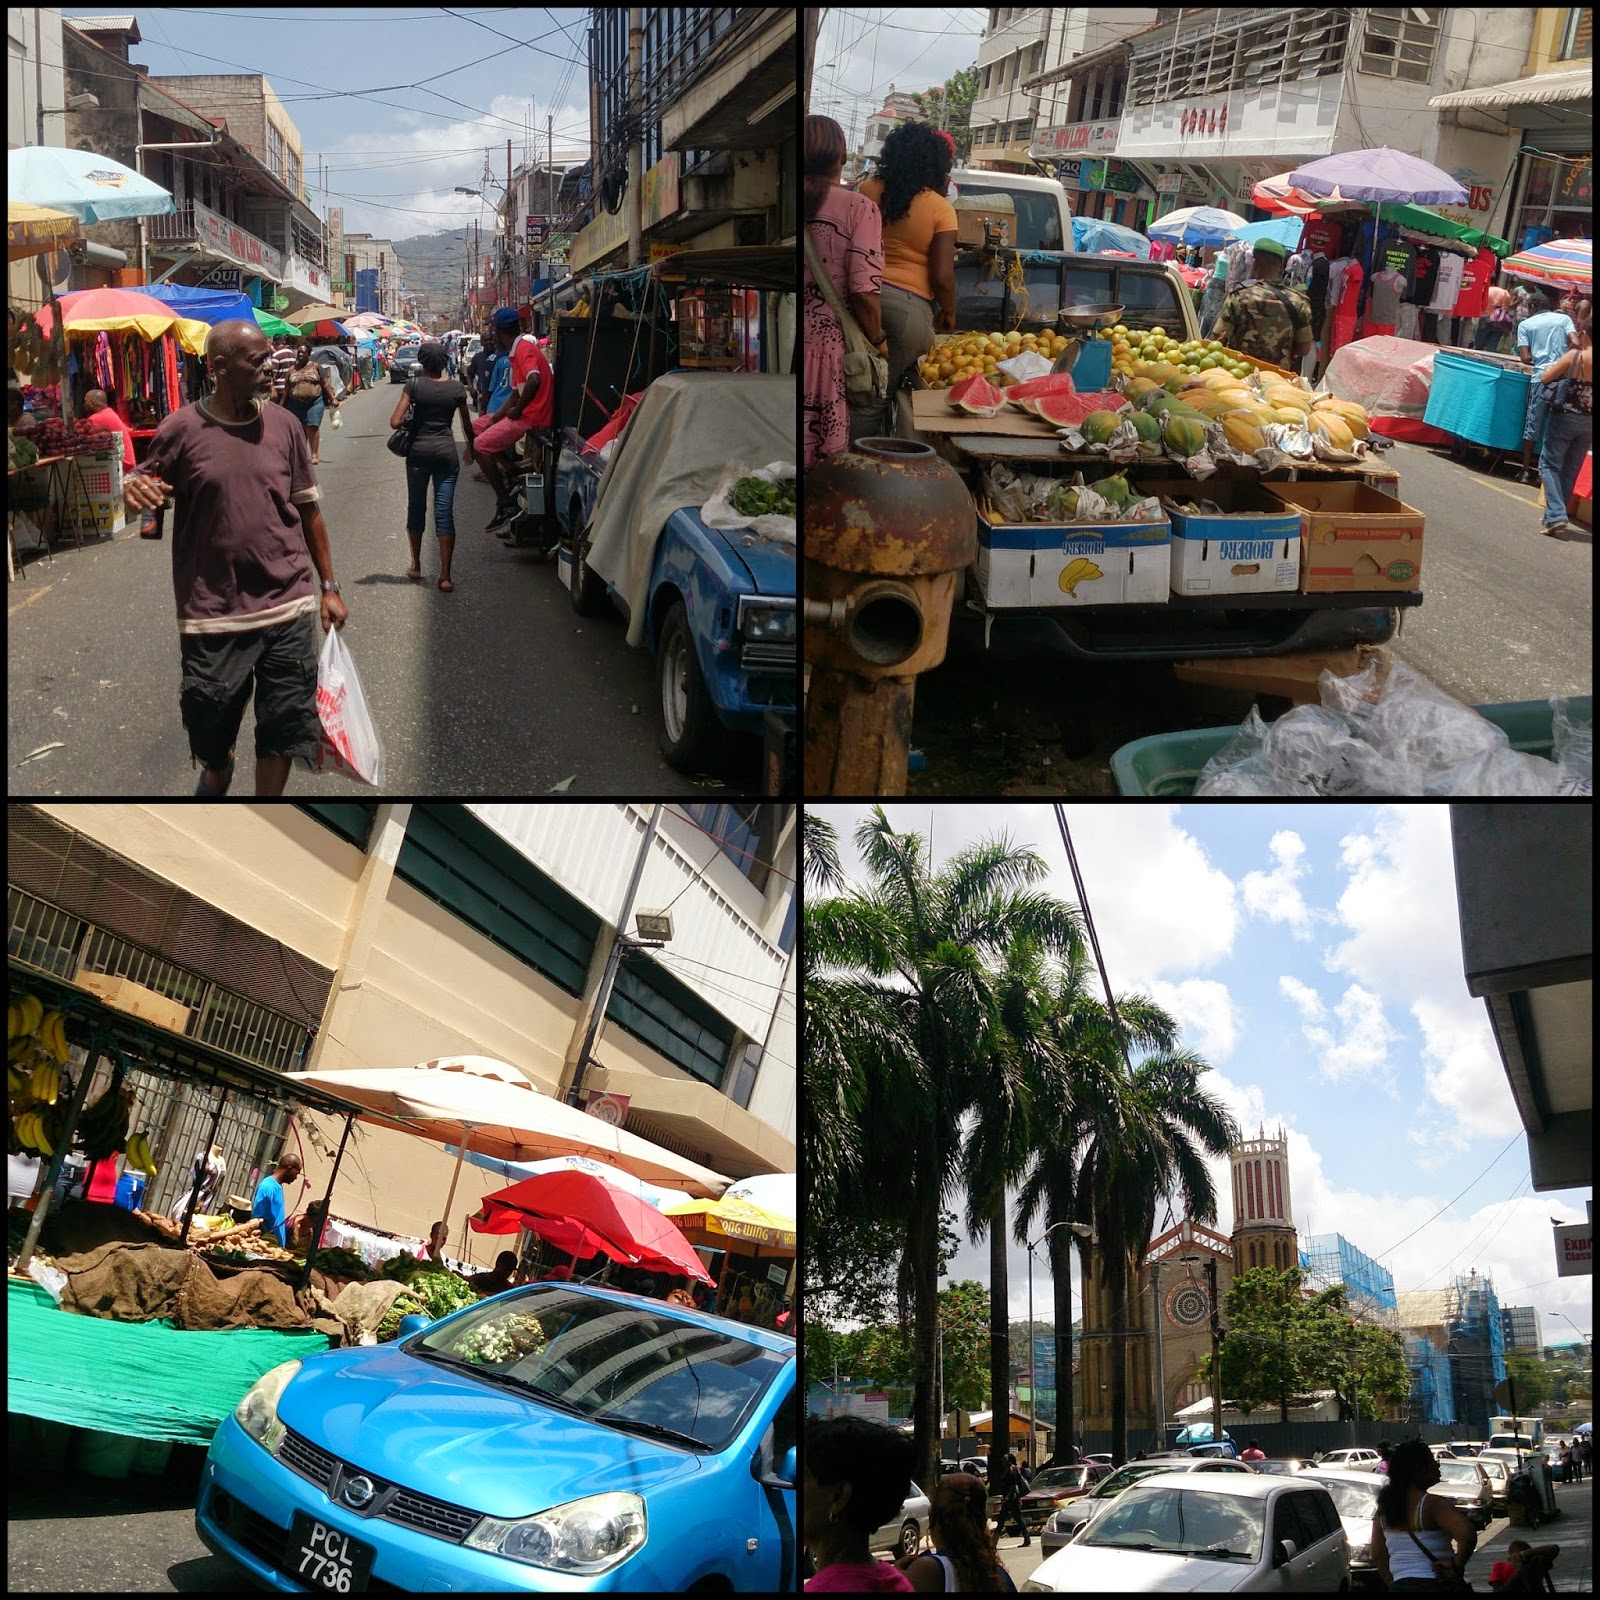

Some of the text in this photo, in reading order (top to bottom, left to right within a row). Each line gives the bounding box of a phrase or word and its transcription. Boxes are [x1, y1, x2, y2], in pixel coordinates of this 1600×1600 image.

[1062, 540, 1105, 555] BIOBERG
[1219, 541, 1273, 560] BIOBERG
[684, 1215, 704, 1227] WING
[743, 1225, 769, 1240] WING
[310, 1522, 353, 1567] PCL
[299, 1546, 353, 1593] 7736
